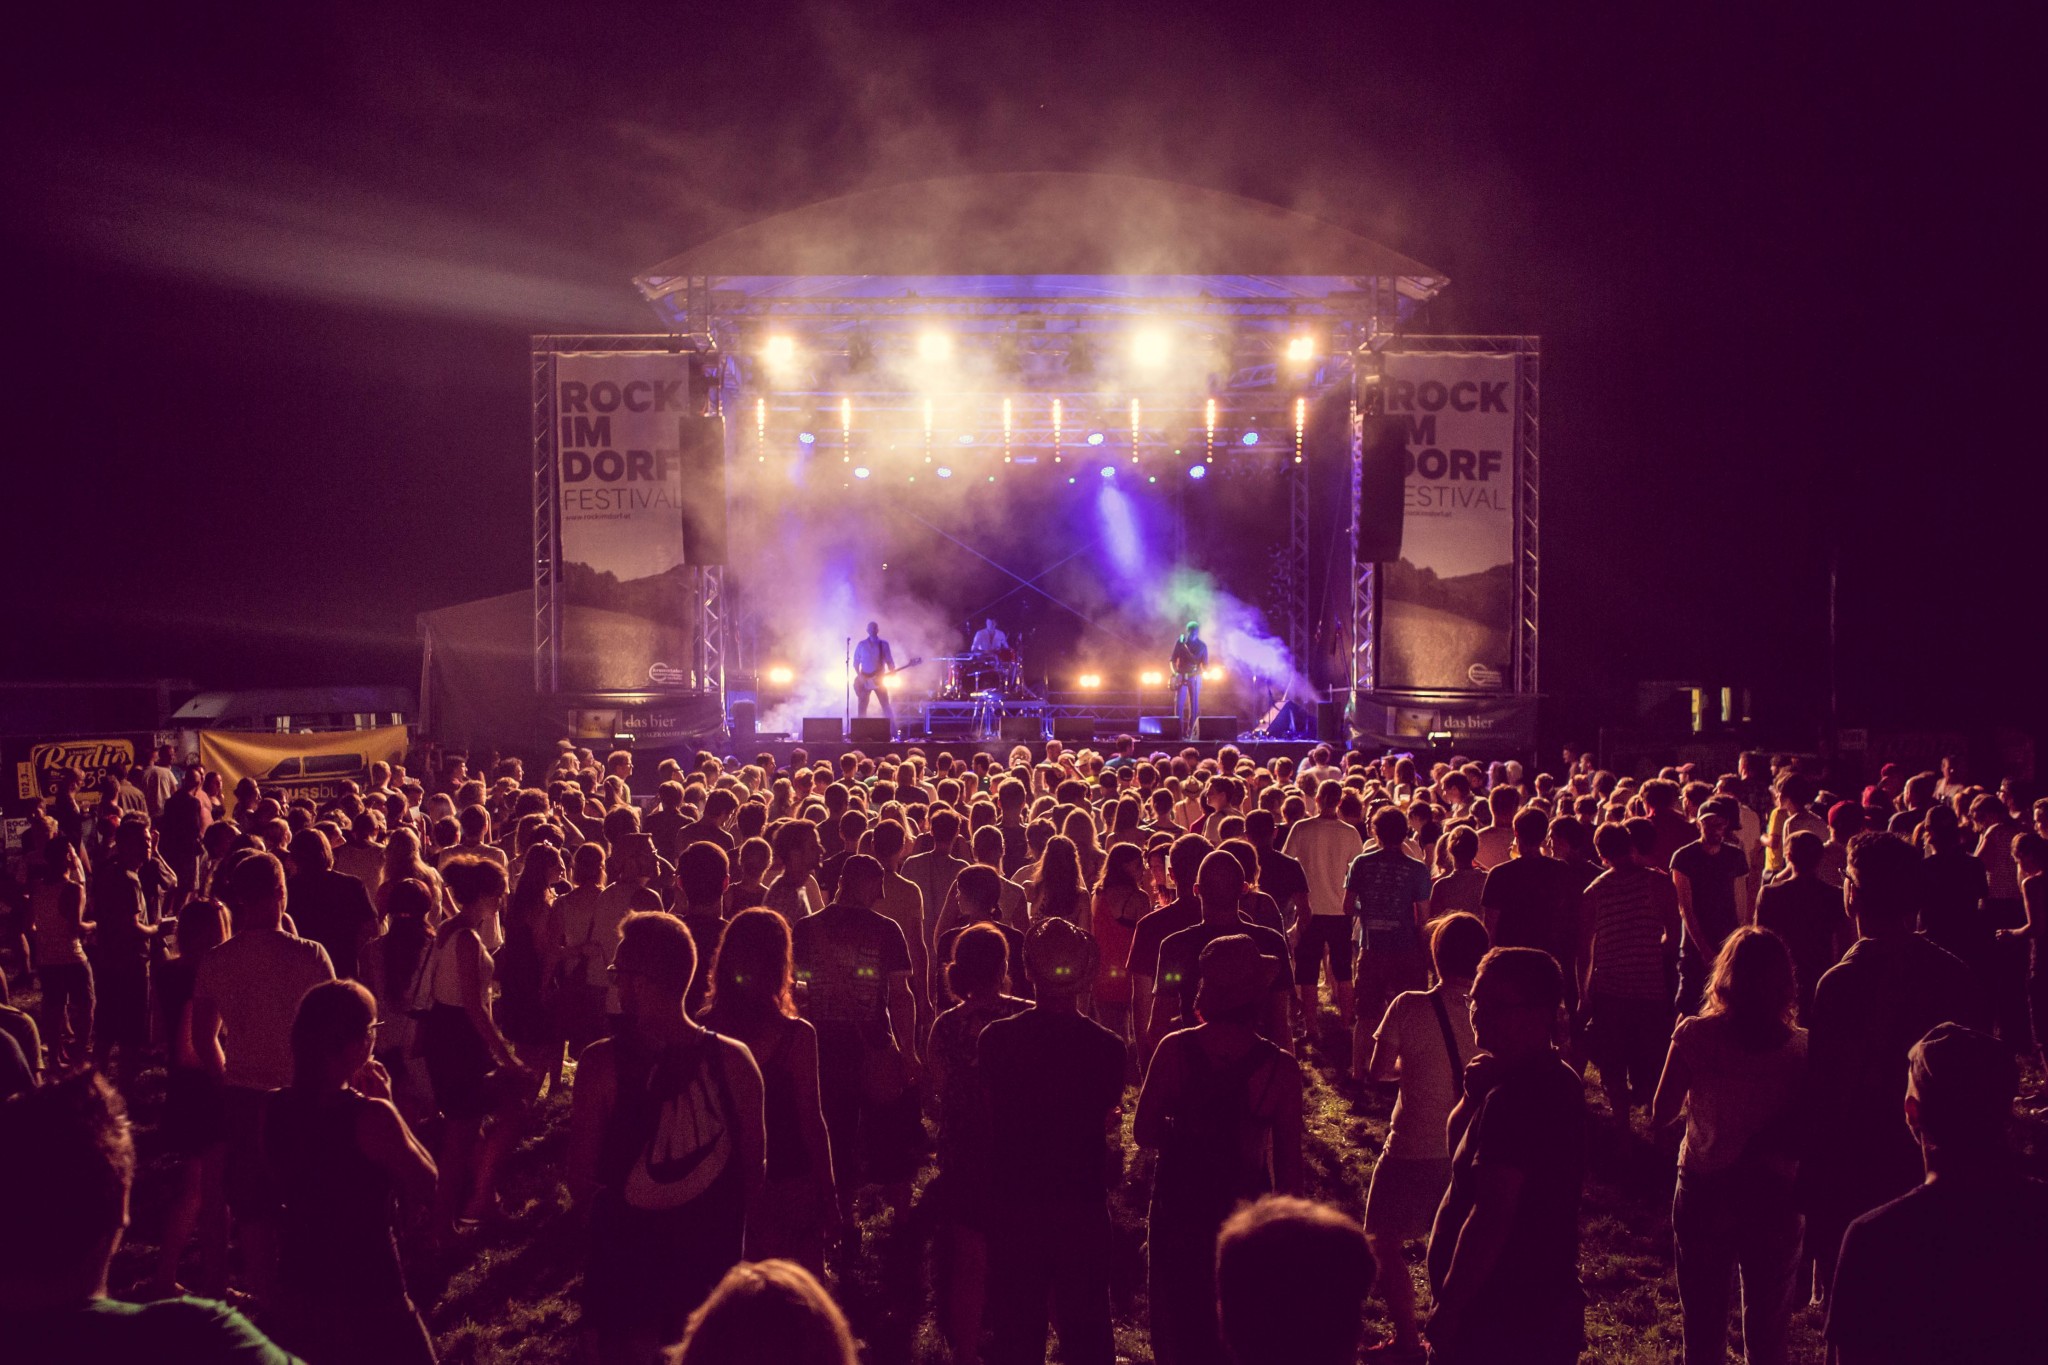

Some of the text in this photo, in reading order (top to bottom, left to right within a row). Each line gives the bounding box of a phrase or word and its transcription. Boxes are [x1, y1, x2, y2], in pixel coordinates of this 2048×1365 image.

[561, 380, 683, 413] ROCK
[1386, 380, 1509, 413] ROCK
[561, 416, 611, 448] IM
[562, 450, 680, 483] DORF
[564, 488, 684, 511] FESTIVAL
[1404, 485, 1507, 510] ESTIVAL
[625, 713, 677, 728] das bier
[1444, 715, 1495, 728] das bier
[40, 744, 129, 771] Radio
